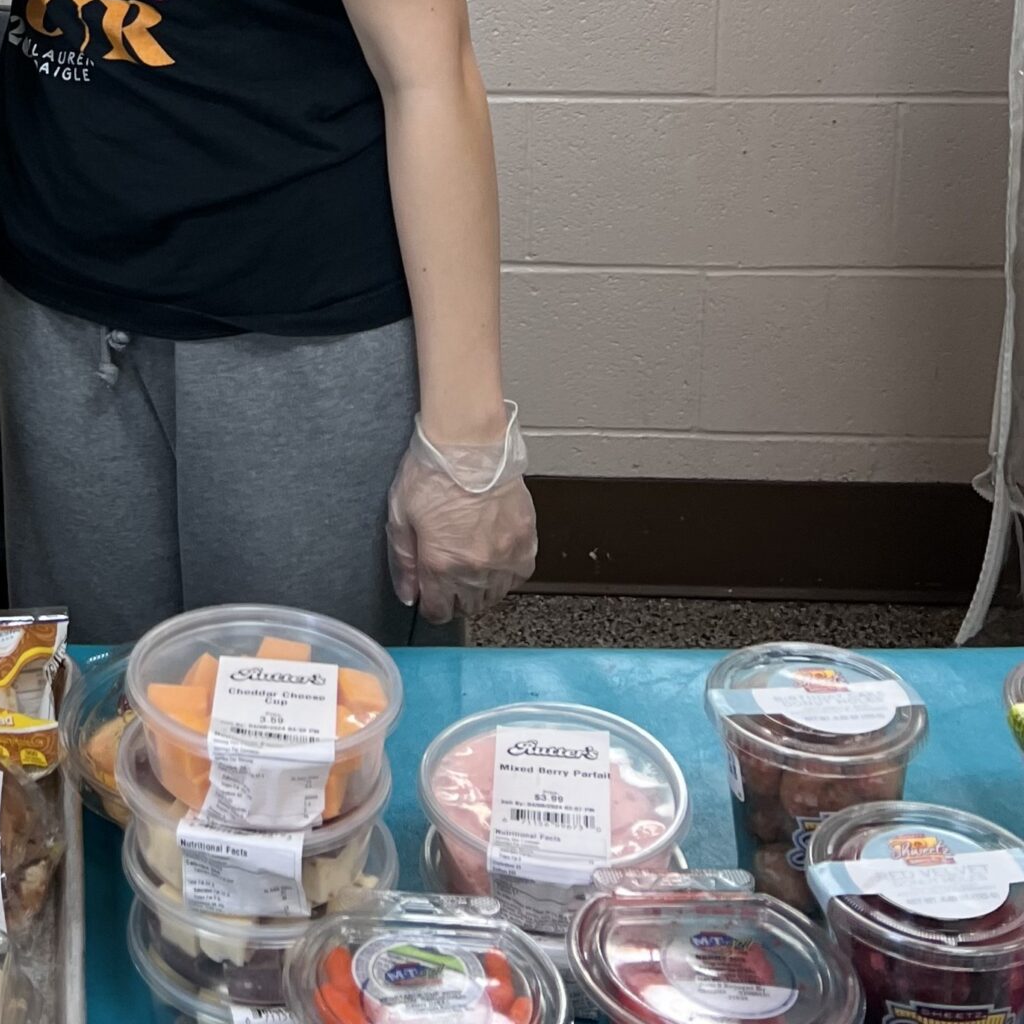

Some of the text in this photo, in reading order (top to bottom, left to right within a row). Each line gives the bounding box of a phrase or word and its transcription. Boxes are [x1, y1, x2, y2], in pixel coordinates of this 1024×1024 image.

[34, 59, 91, 82] AIGLE
[230, 667, 326, 686] Rutter's
[228, 687, 326, 701] Cheddar Cheese
[265, 696, 288, 706] Cup
[507, 739, 599, 761] Rutter's
[499, 763, 611, 780] Mixed Berry Parfait
[180, 839, 248, 857] Nutritional Facts
